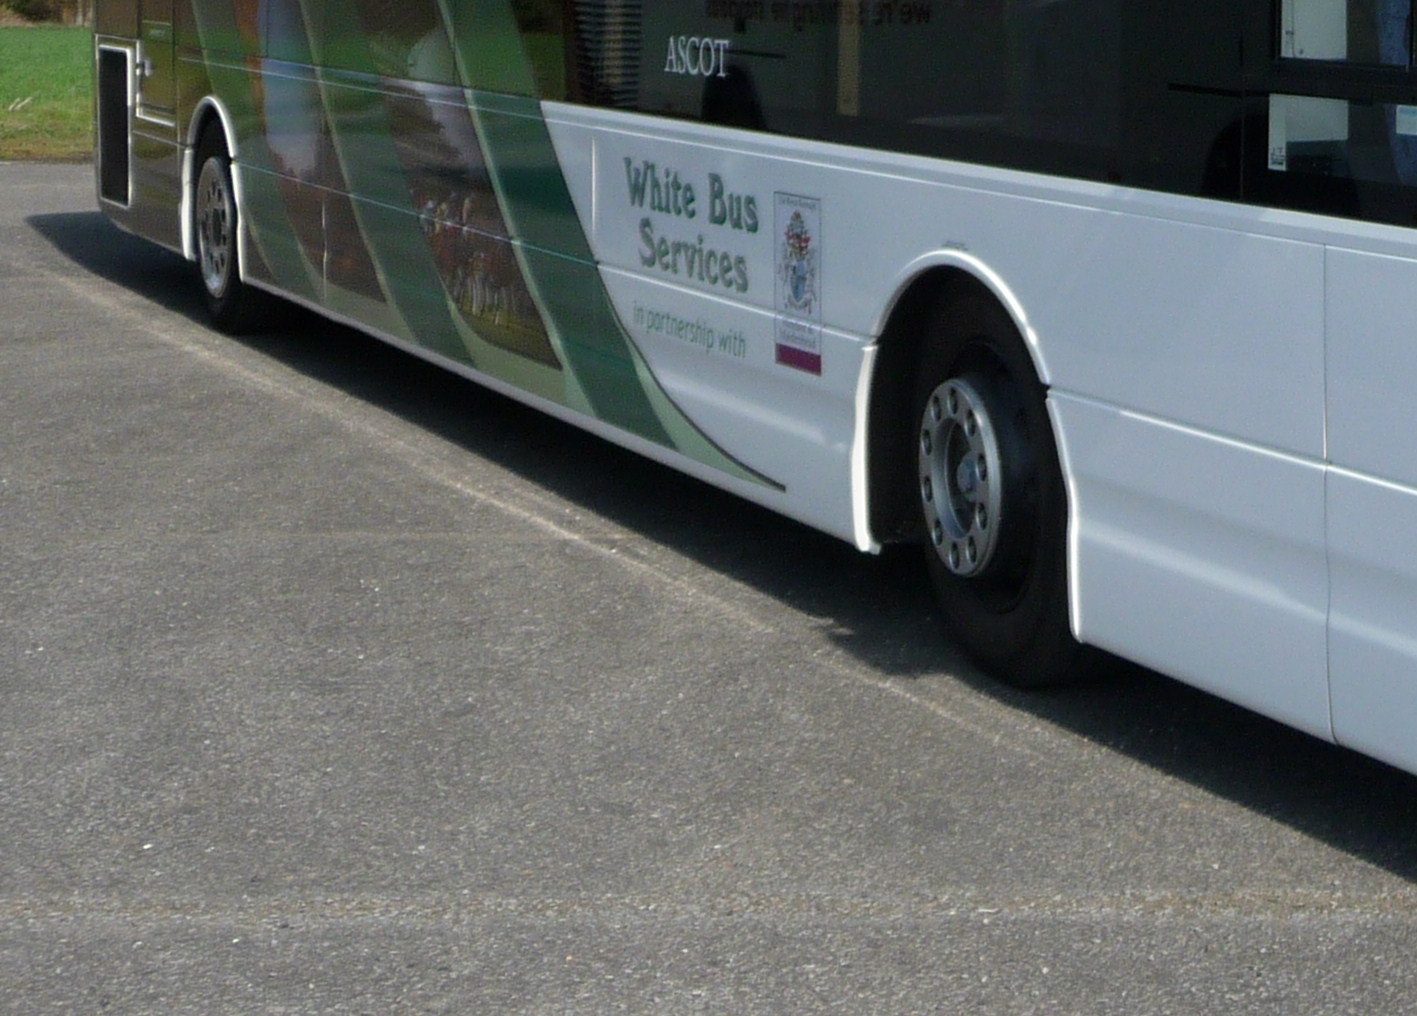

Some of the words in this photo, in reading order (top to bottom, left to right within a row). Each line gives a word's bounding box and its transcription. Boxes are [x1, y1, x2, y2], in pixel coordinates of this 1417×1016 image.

[665, 35, 730, 78] ASCOT
[624, 157, 696, 219] White
[708, 172, 759, 233] Bus
[638, 217, 749, 294] Services
[633, 300, 644, 325] in
[646, 310, 714, 356] partnership
[718, 327, 747, 359] with
